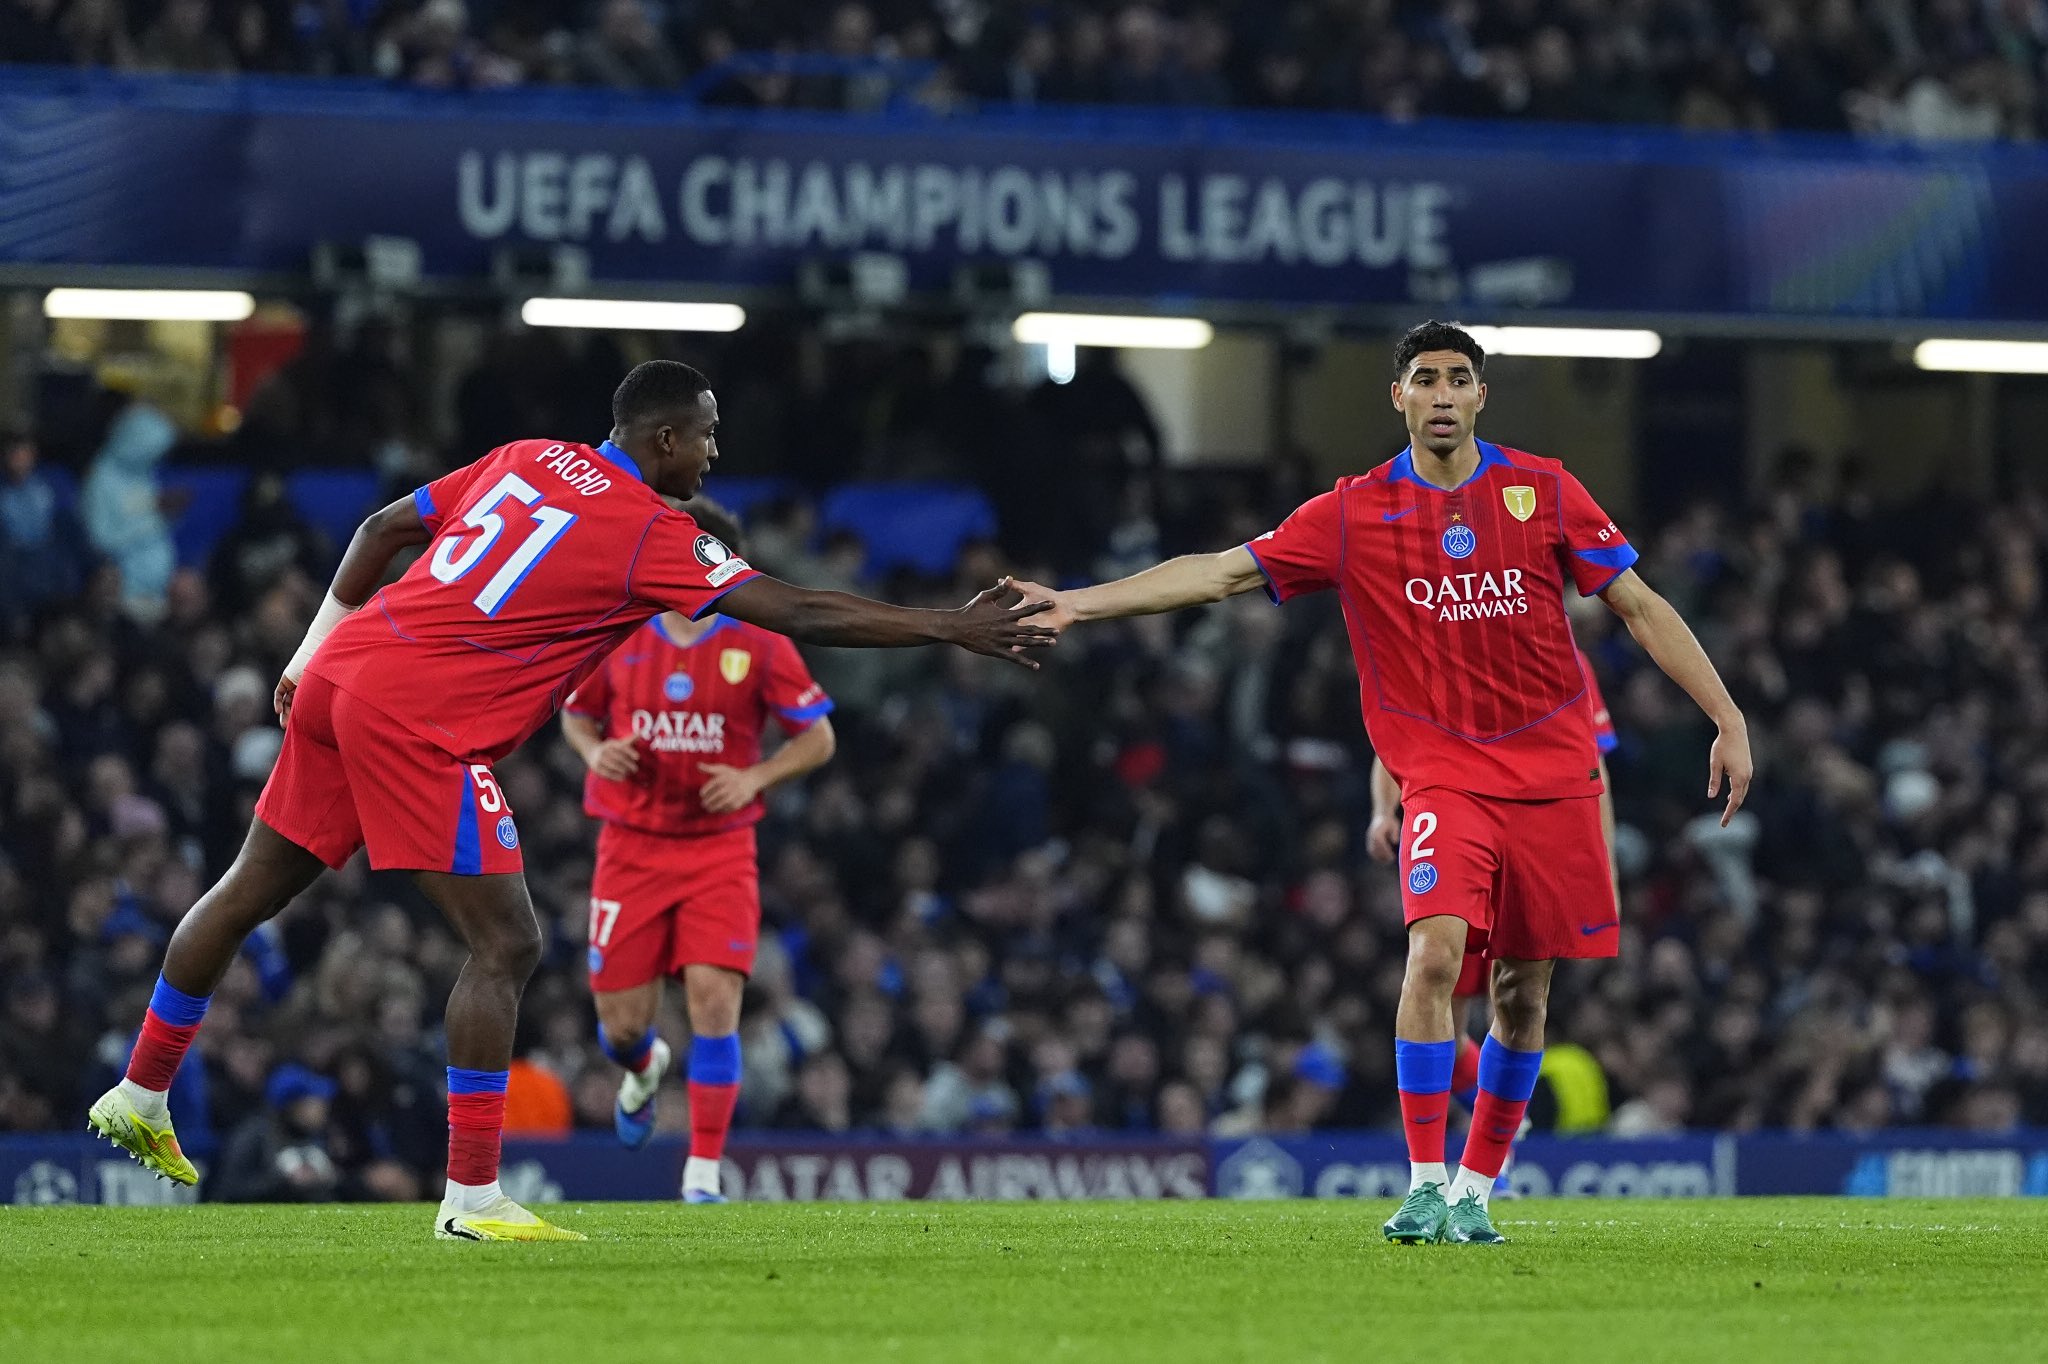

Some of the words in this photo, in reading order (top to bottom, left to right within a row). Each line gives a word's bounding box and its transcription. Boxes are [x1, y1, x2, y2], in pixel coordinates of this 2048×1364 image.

[458, 151, 666, 243] UEFA
[679, 155, 1141, 260] CHAMPIONS
[1158, 172, 1452, 269] LEAGUE
[535, 444, 612, 497] PACHO
[429, 471, 579, 620] 51
[1447, 527, 1469, 537] PARIS
[1405, 568, 1525, 610] QATAR
[1438, 596, 1528, 622] AIRWAYS
[632, 709, 725, 740] QATAR
[470, 765, 514, 813] 5
[1411, 812, 1437, 861] 2
[926, 1154, 1206, 1200] AIRWAYS
